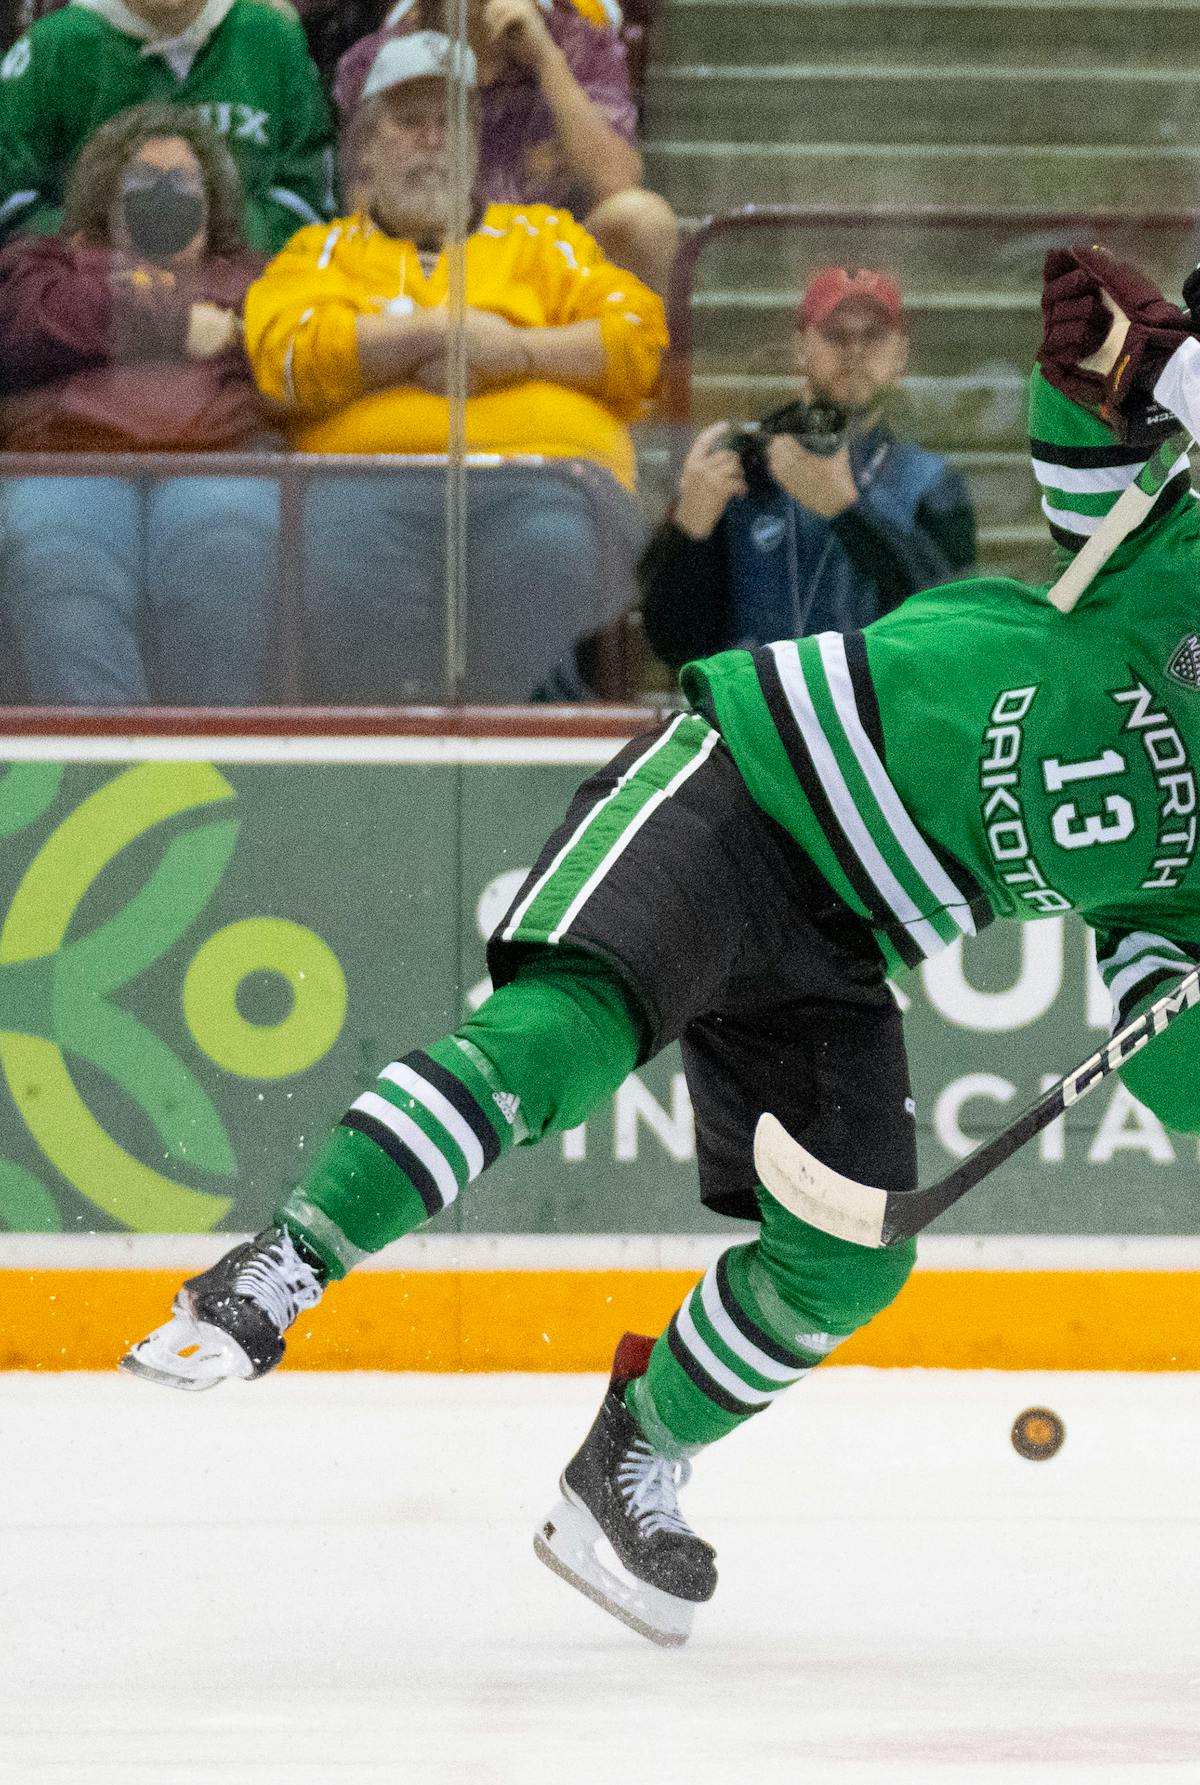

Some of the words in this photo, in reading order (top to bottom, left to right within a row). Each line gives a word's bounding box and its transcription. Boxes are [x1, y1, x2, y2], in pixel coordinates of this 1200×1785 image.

[981, 685, 1073, 913] DAKOTA
[1043, 749, 1136, 850] 13
[1113, 681, 1197, 889] NORTH
[1062, 971, 1200, 1107] CCM
